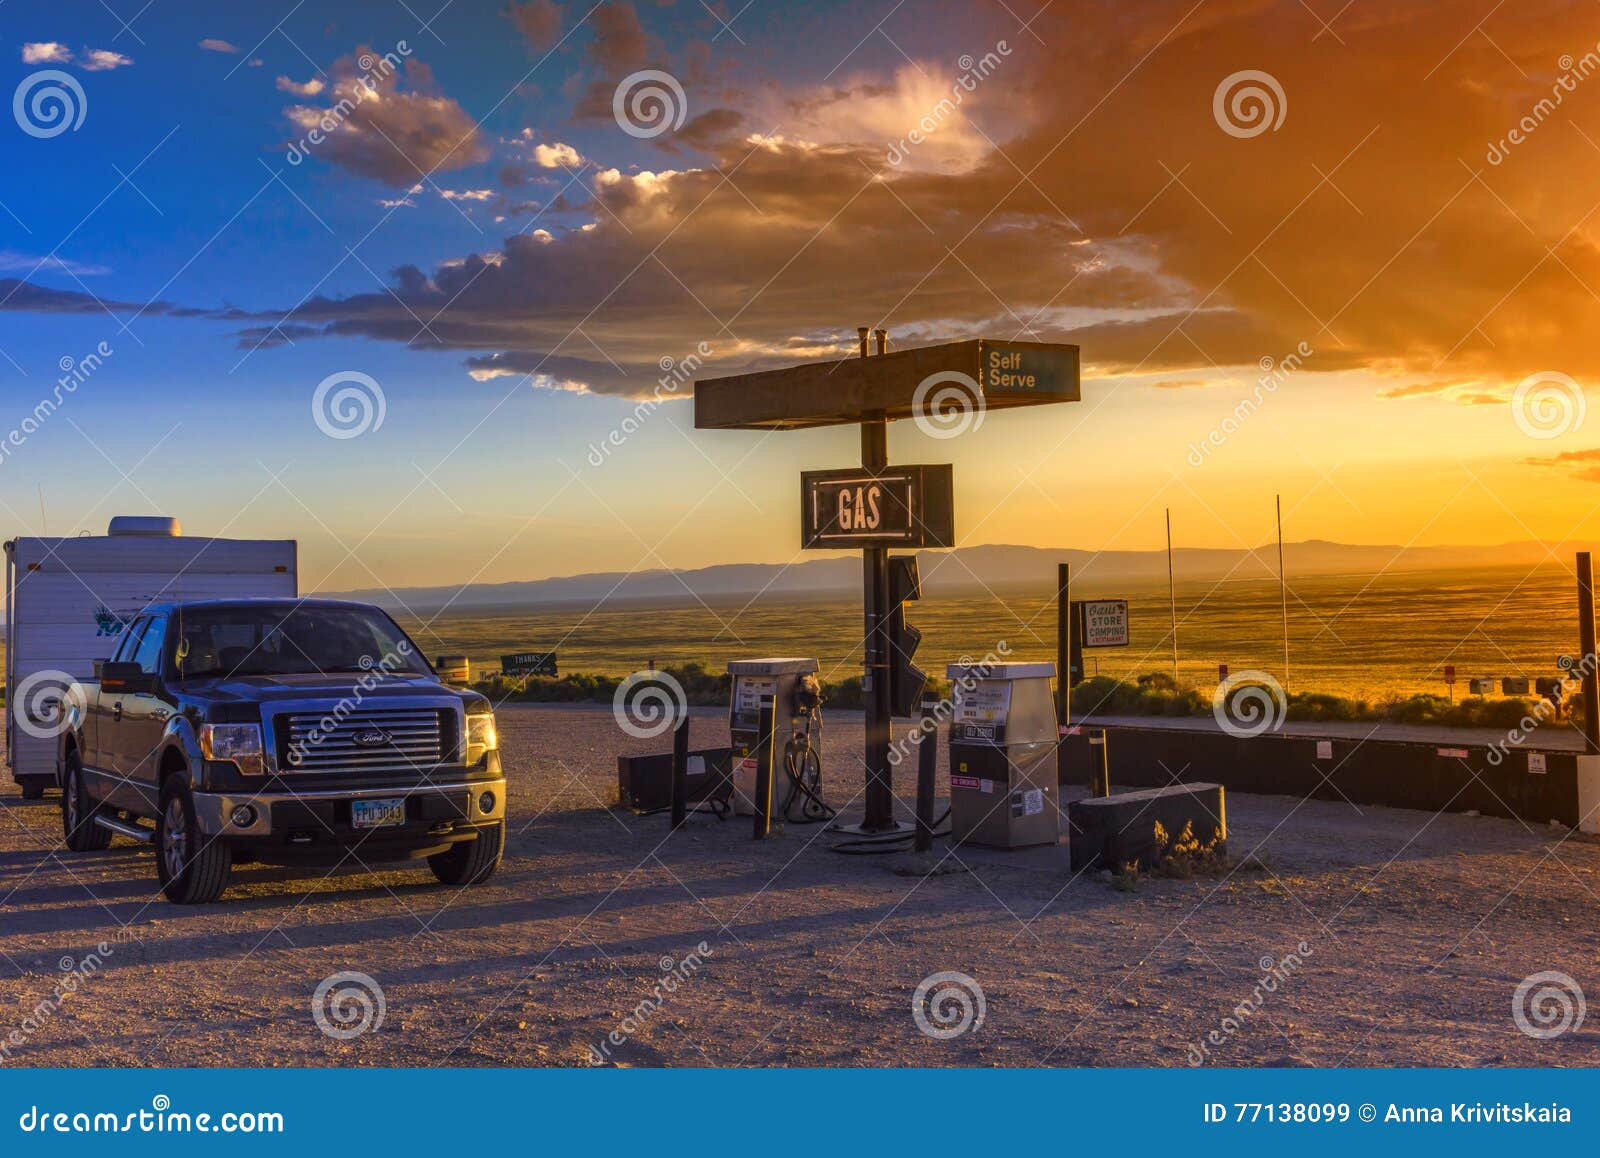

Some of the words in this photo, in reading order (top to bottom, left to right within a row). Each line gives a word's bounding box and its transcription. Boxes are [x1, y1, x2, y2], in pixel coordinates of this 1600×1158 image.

[989, 351, 1021, 369] Self
[989, 368, 1036, 387] Serve
[839, 486, 880, 530] GAS
[1091, 615, 1122, 626] STORE
[1089, 626, 1125, 637] CAMPING
[362, 732, 383, 742] Ford
